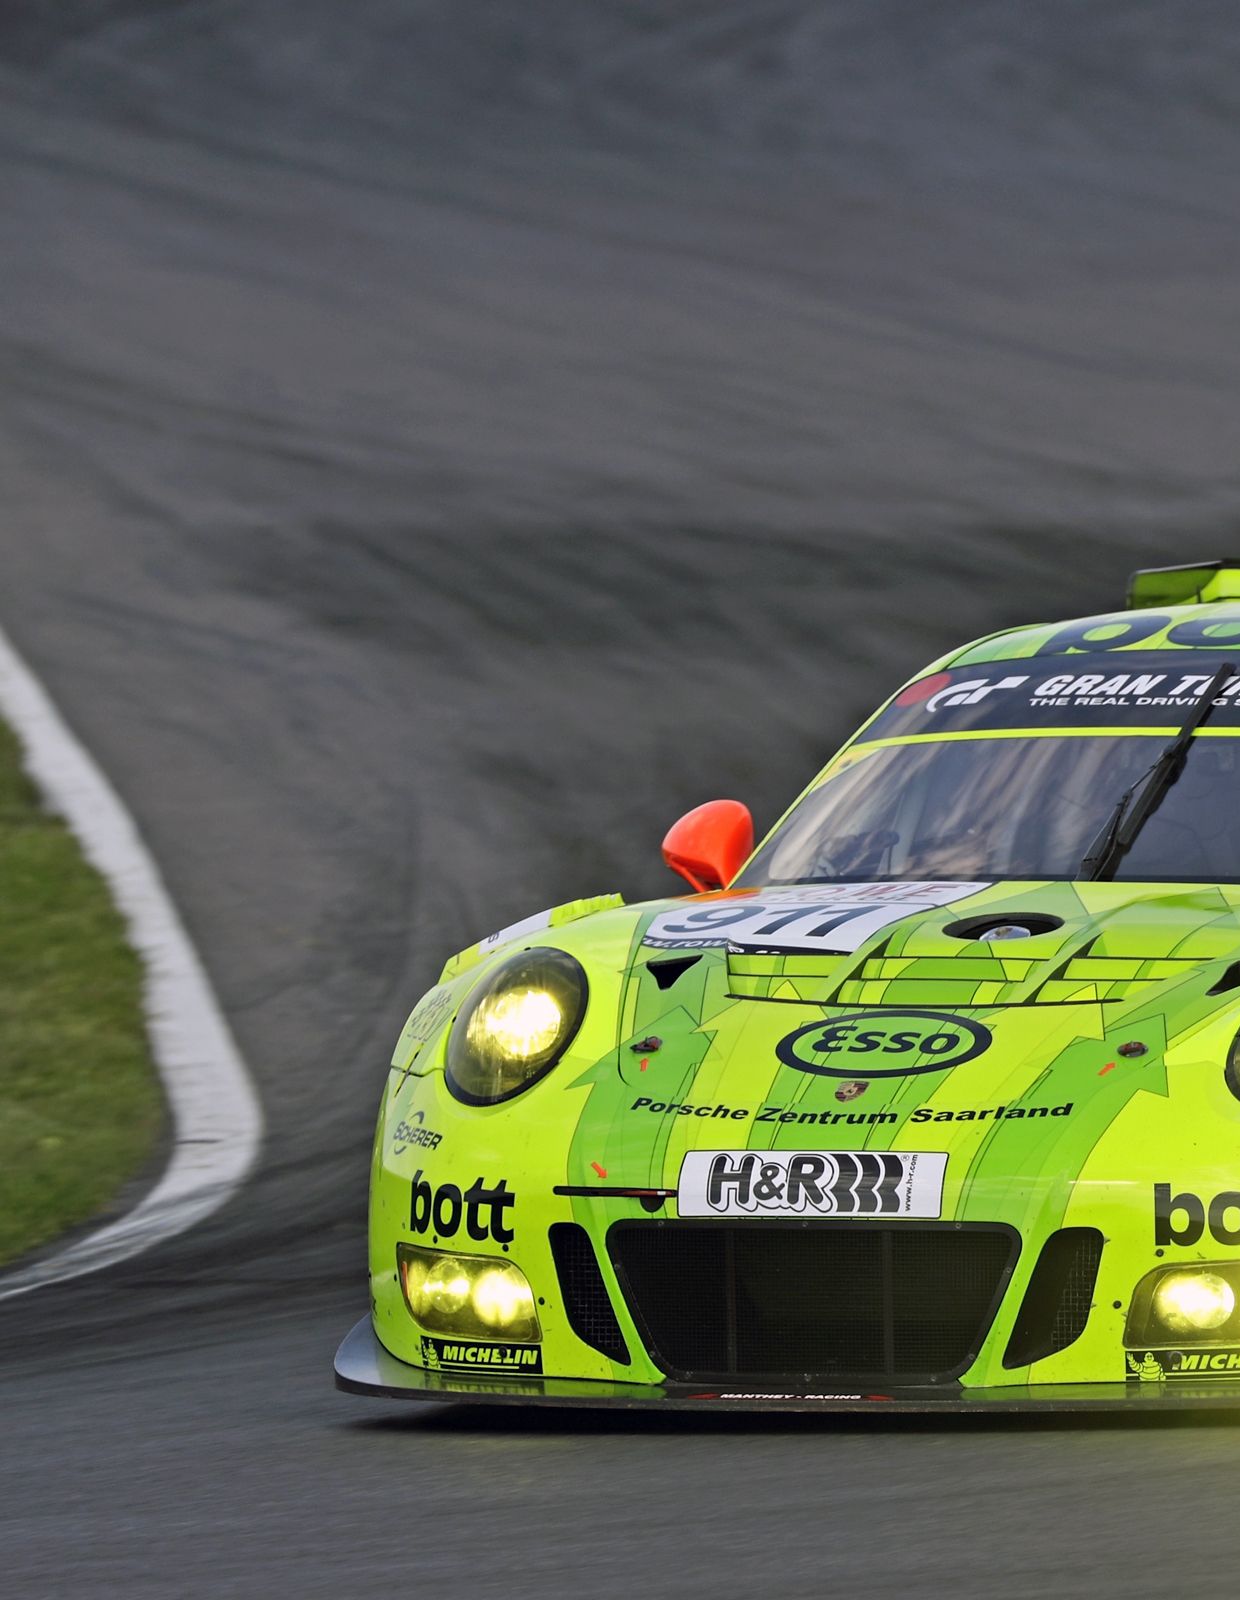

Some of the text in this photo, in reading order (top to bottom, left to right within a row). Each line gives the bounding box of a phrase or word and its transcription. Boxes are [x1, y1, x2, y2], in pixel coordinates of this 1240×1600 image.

[1033, 674, 1168, 697] GRAN
[1029, 697, 1070, 707] THE
[1073, 697, 1131, 706] REAL
[1135, 697, 1229, 707] DRIVIG
[662, 904, 886, 937] 911
[630, 1097, 1074, 1125] Porsche Zentrum Saarland
[410, 1169, 516, 1243] bott
[443, 1345, 538, 1365] MICHELIN
